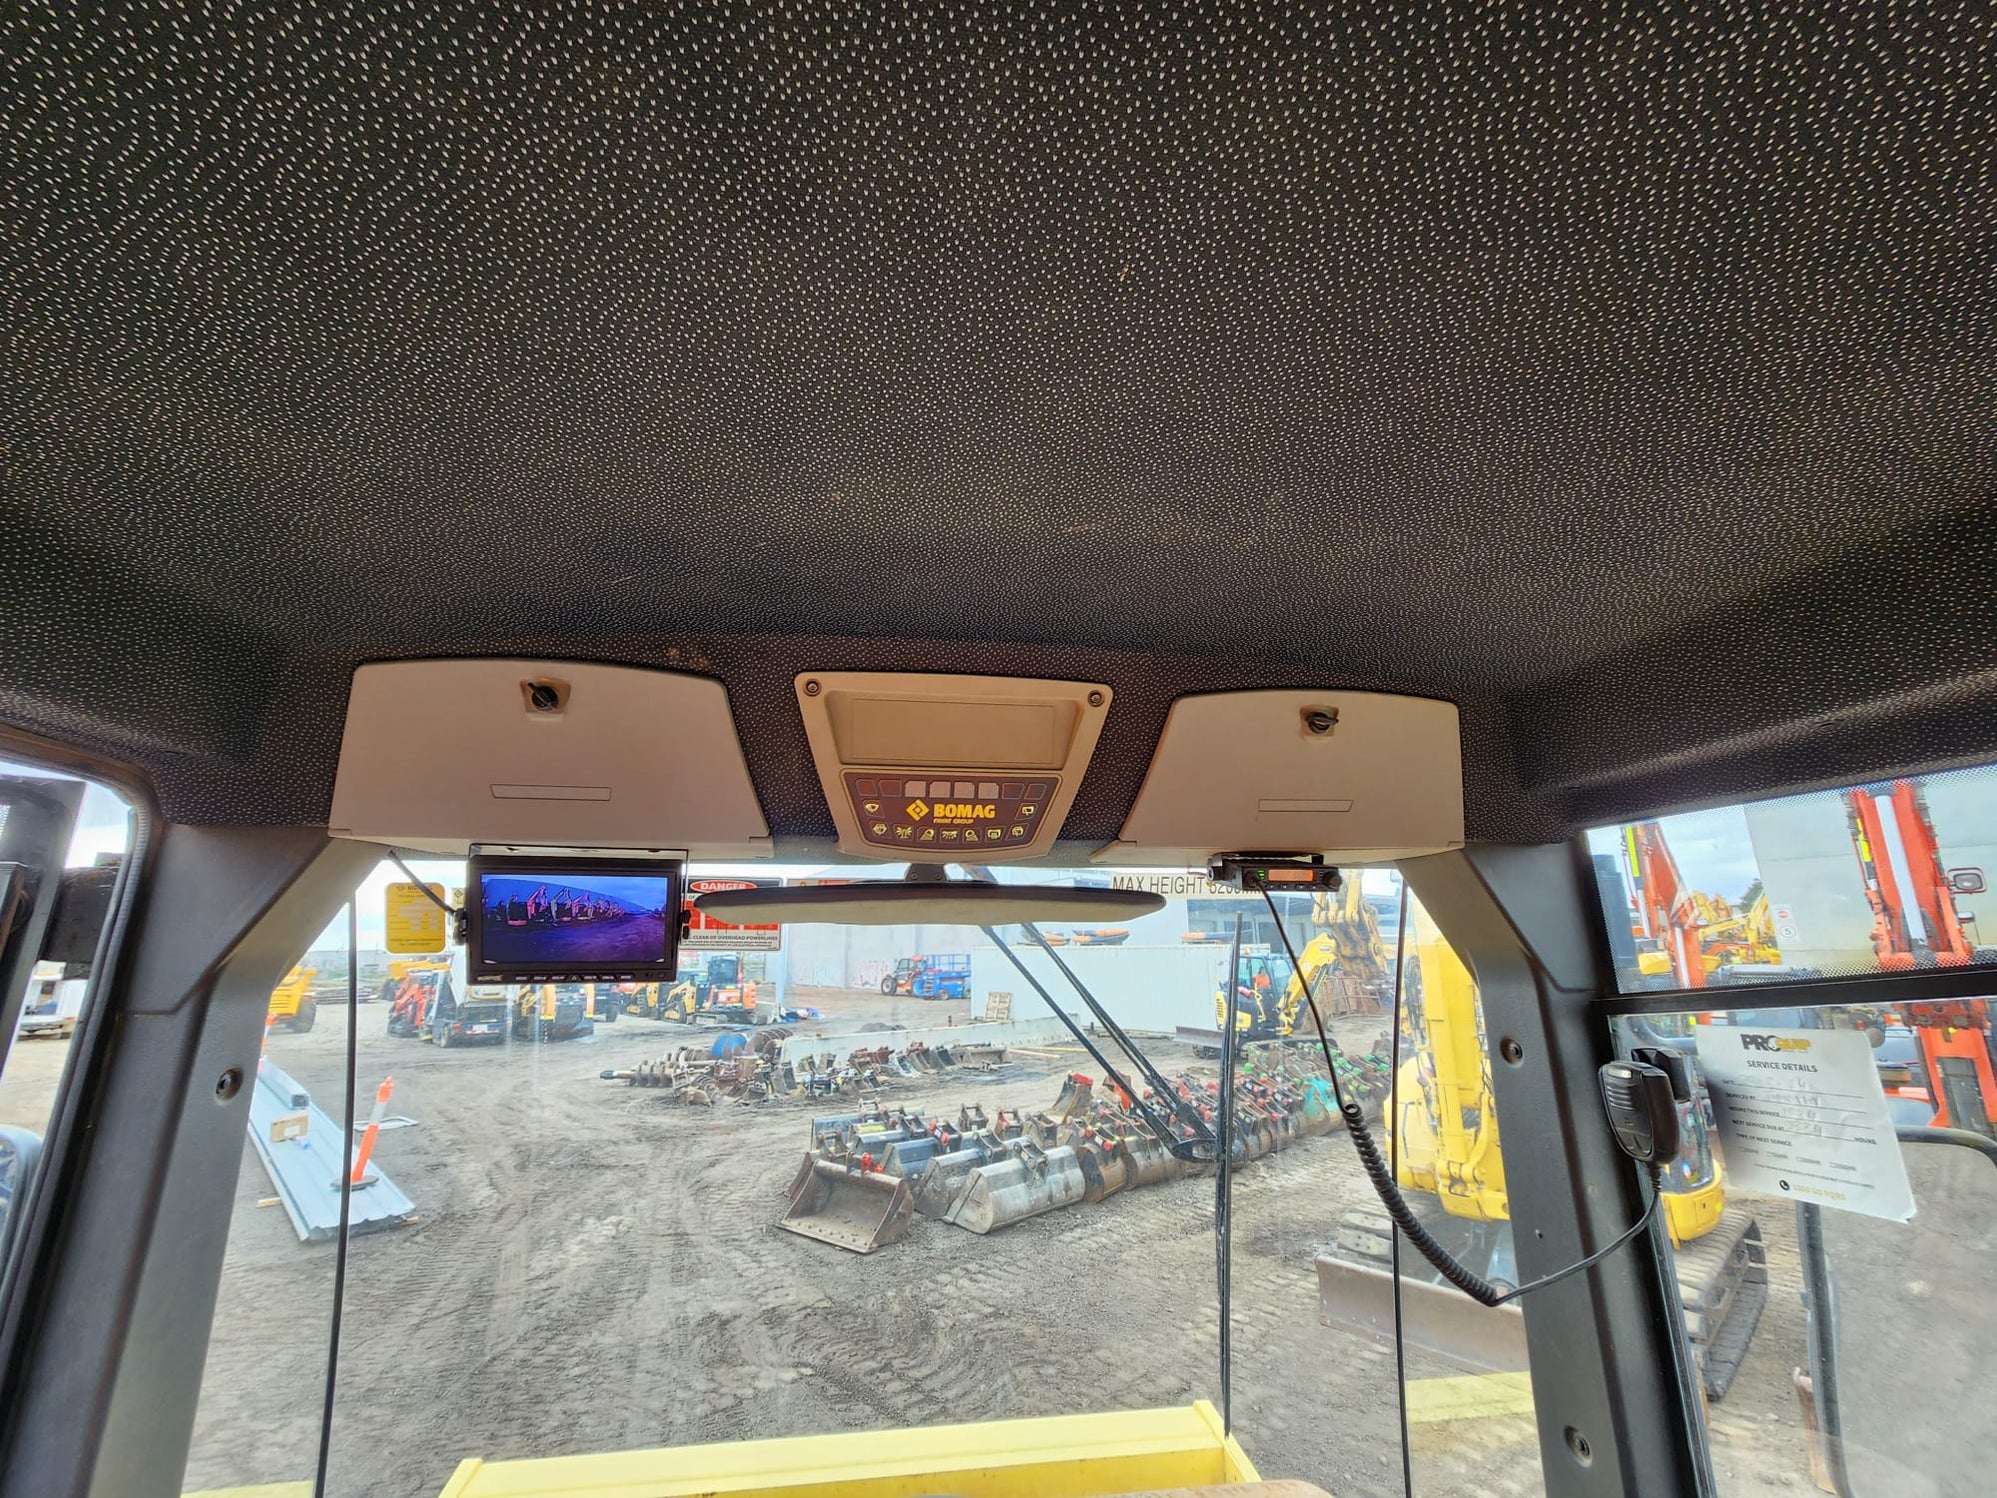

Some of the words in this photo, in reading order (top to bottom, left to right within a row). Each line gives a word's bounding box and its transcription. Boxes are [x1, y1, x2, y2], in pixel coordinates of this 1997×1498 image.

[933, 803, 996, 819] BOMAG
[700, 882, 746, 892] DANGER
[1112, 876, 1145, 891] MAX
[1149, 876, 1206, 894] HEIGHT
[1746, 1059, 1780, 1070] SERVICE
[1781, 1063, 1818, 1073] DETAILS
